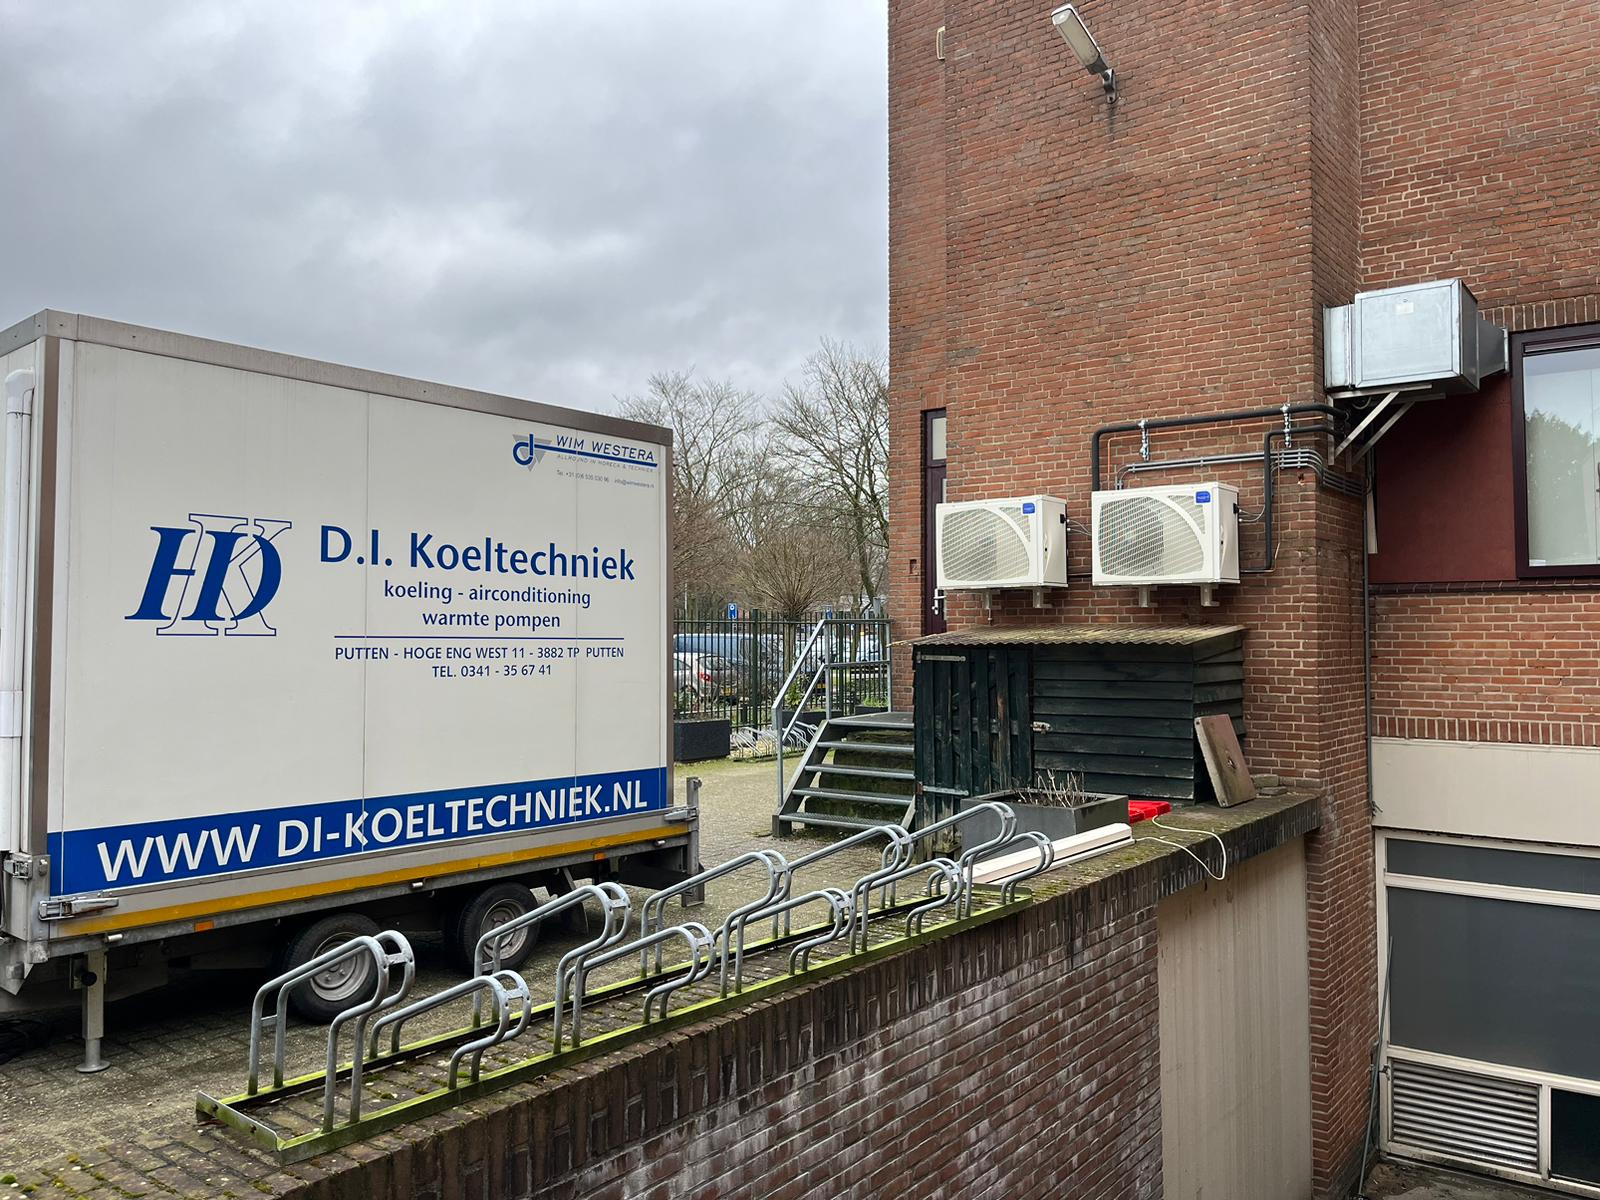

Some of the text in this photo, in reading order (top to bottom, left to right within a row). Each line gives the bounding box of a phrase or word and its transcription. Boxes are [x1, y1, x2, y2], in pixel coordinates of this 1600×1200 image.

[556, 434, 655, 462] WIM WESTERA
[320, 524, 636, 581] D.I. Koeltechniek
[384, 579, 452, 605] koeling
[468, 586, 591, 609] airconditioning
[422, 611, 561, 632] warmte pompen
[335, 647, 389, 660] PUTTEN
[403, 646, 442, 660] HOGE
[446, 646, 472, 660] ENG
[475, 646, 508, 660] WEST
[511, 647, 525, 659] 11
[537, 647, 564, 659] 3882
[566, 647, 580, 658] TP
[586, 646, 624, 659] PUTTEN
[431, 665, 457, 678] TEL.
[460, 665, 491, 677] 0341
[503, 664, 518, 677] 35
[521, 664, 535, 676] 67
[538, 664, 552, 676] 41
[97, 780, 648, 881] WWW DI-KOELTECHNIEK.NL
